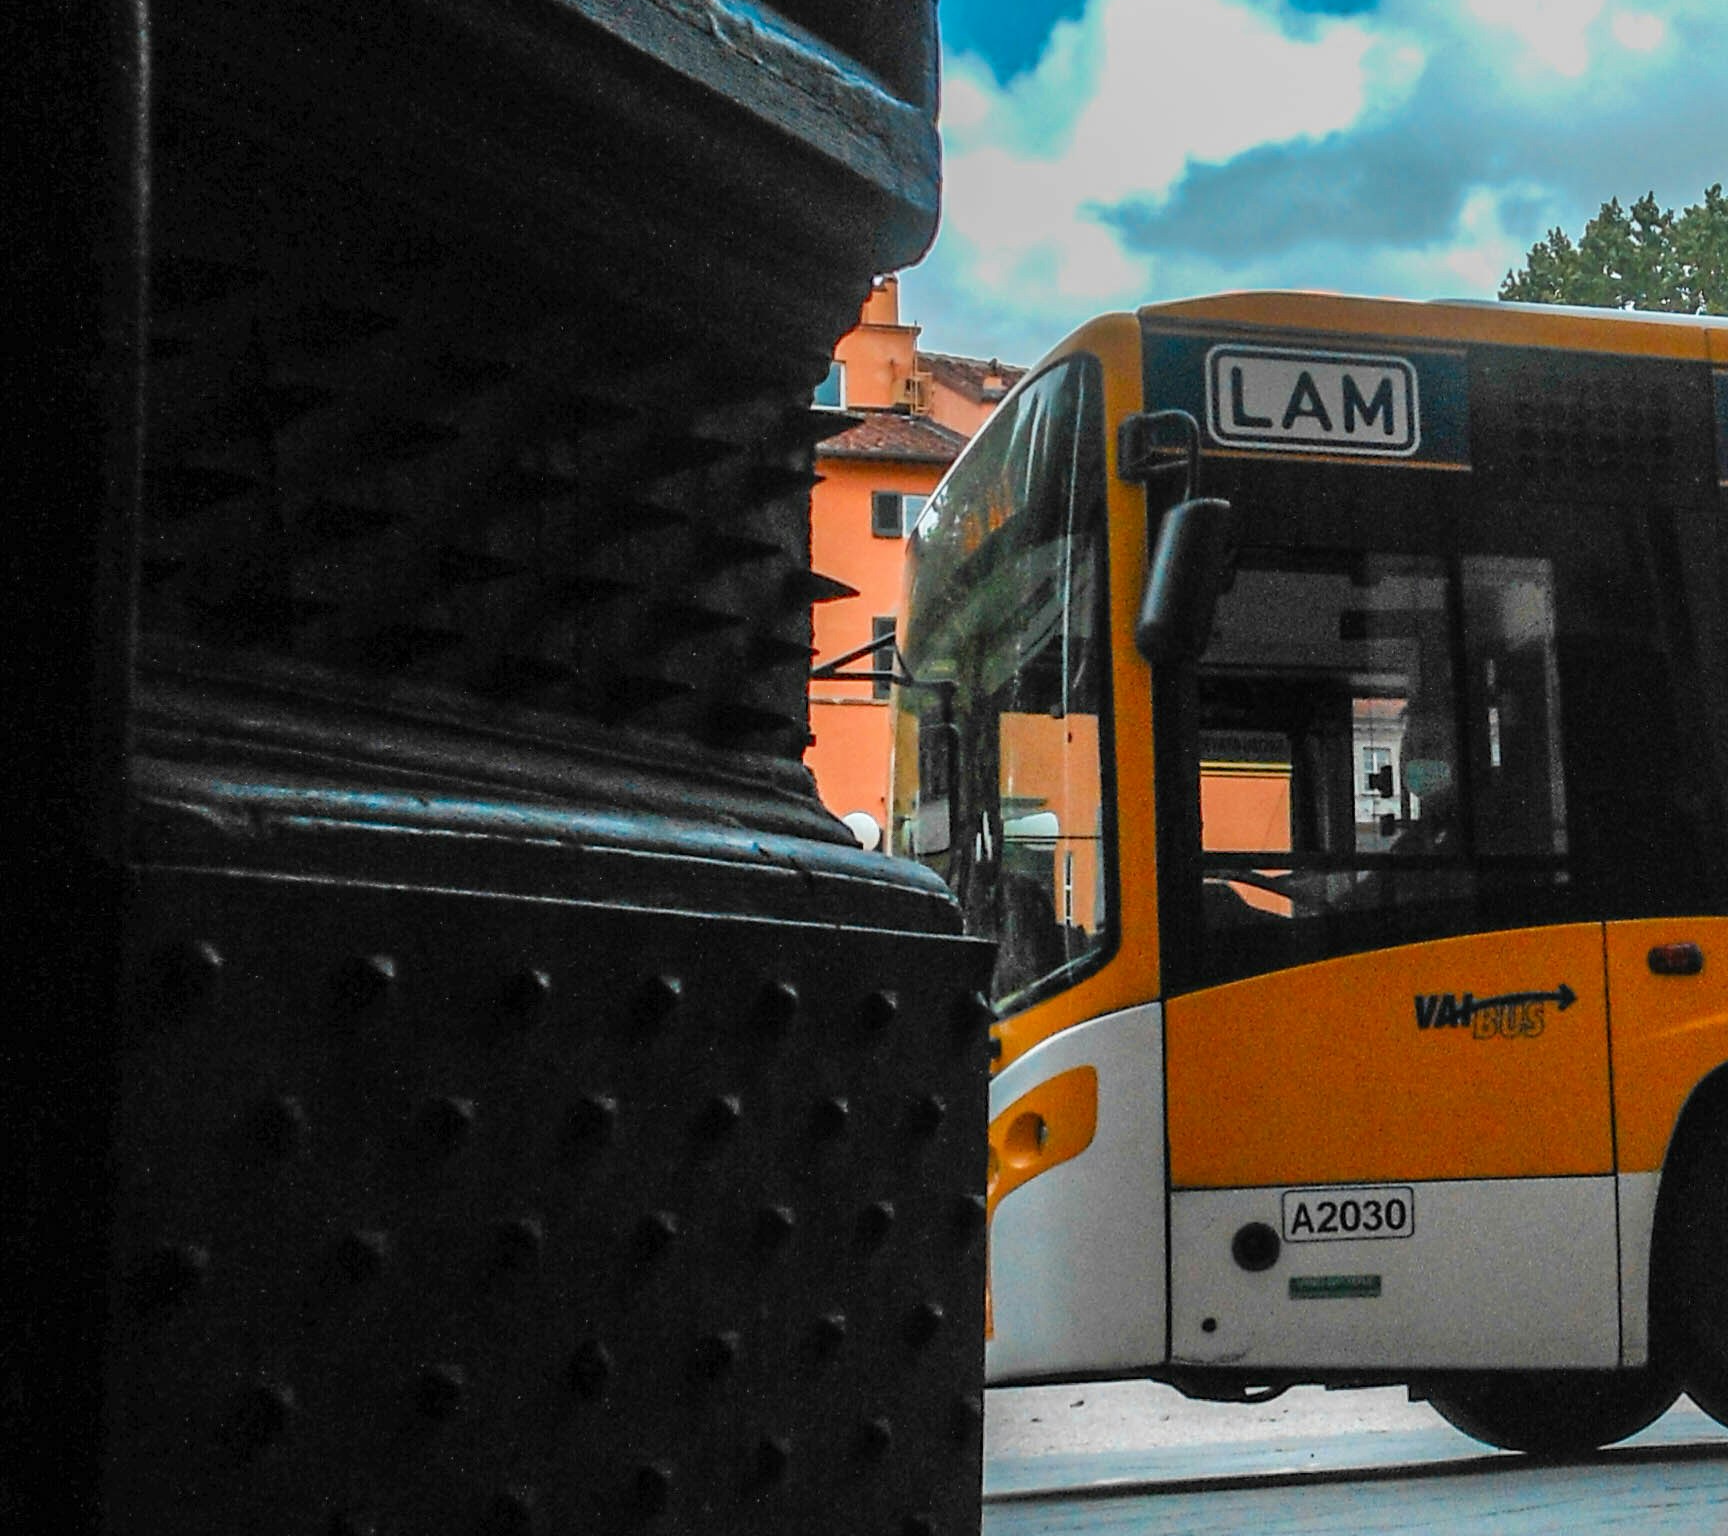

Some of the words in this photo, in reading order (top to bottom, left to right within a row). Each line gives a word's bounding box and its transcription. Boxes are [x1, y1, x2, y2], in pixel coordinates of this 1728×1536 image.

[1231, 366, 1394, 436] LAM
[1473, 1002, 1545, 1040] BUS
[1291, 1198, 1406, 1235] A2030
